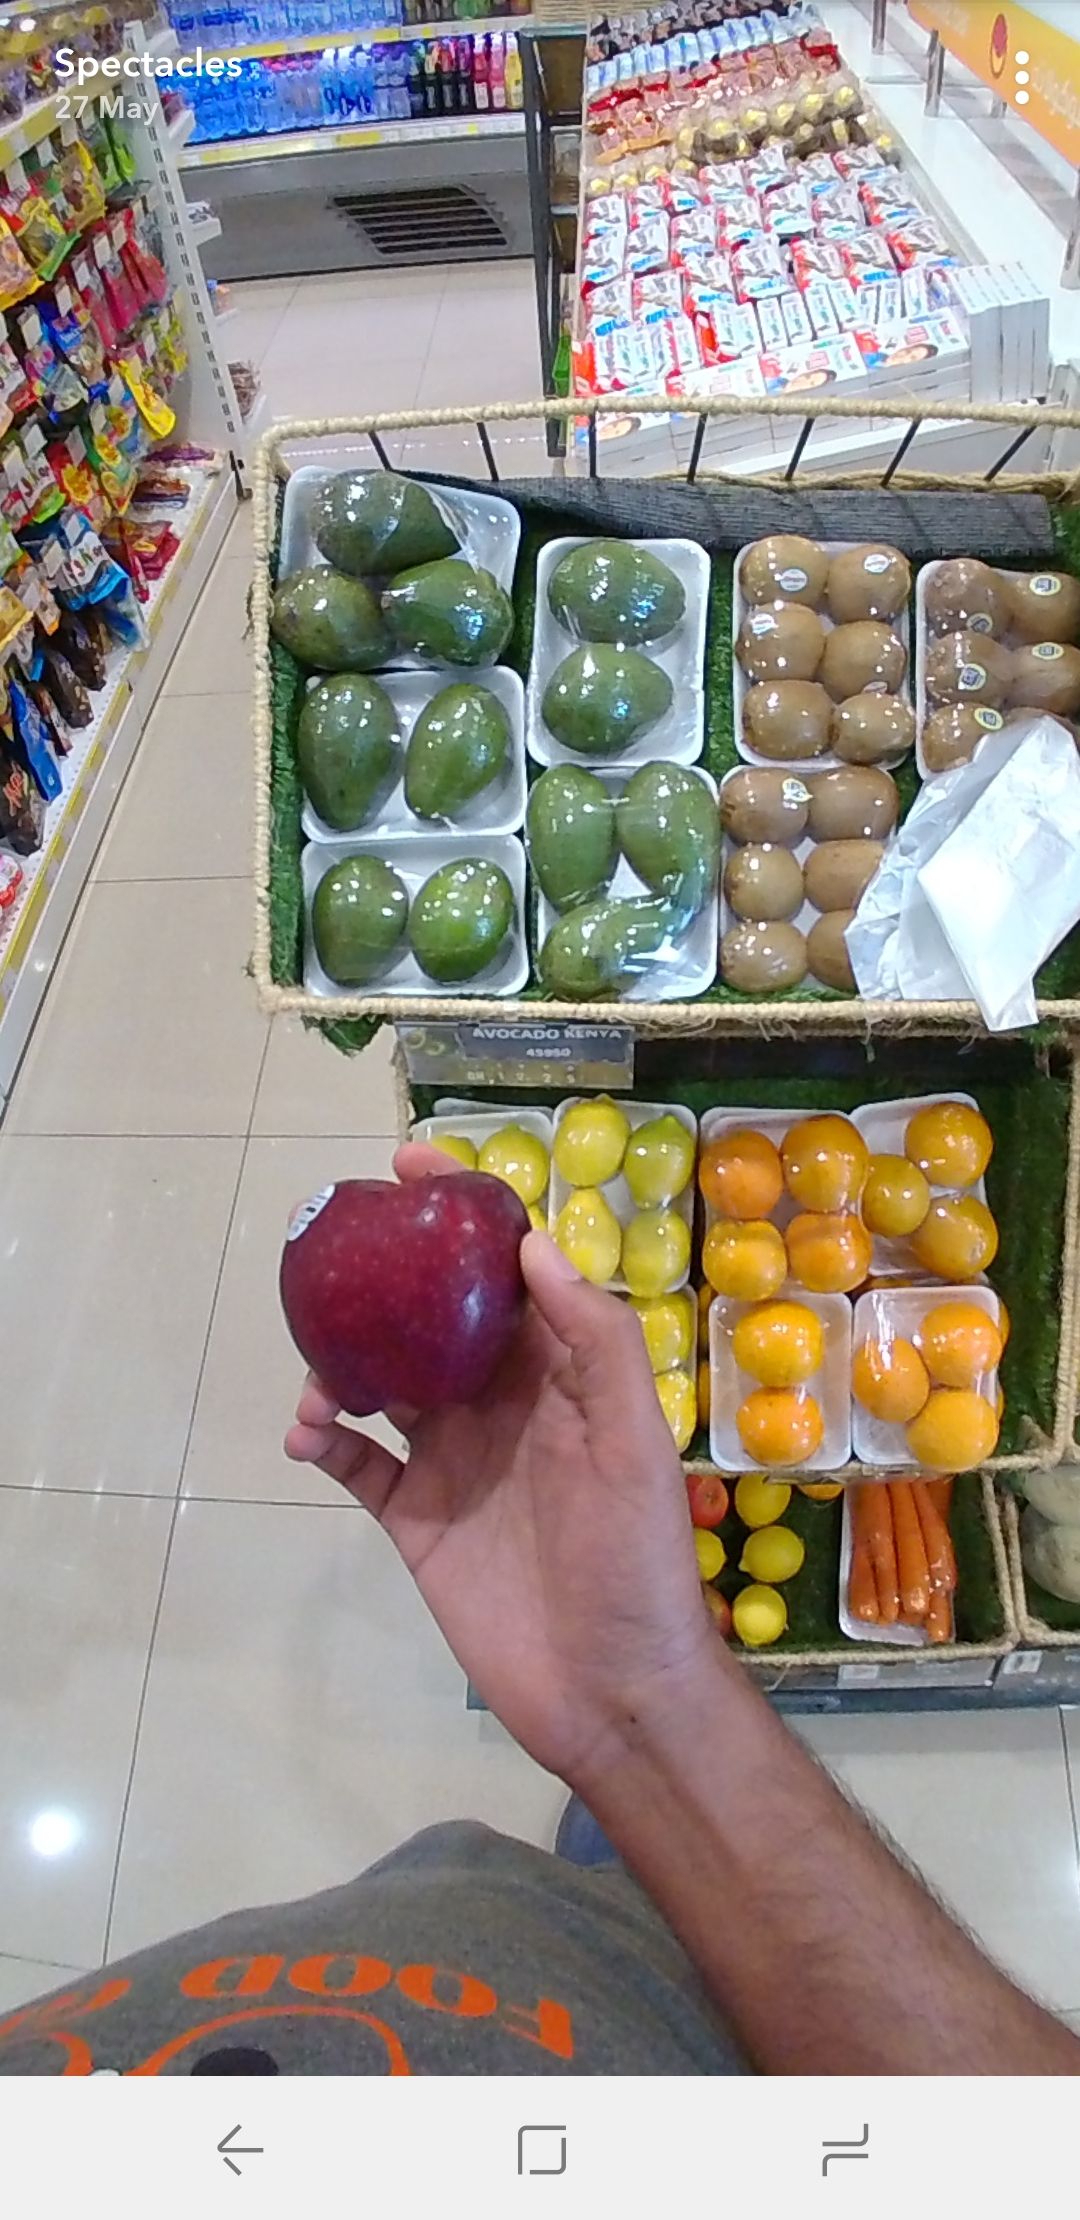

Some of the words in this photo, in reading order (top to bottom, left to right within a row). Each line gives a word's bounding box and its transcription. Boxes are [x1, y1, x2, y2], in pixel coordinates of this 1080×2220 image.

[472, 1029, 560, 1040] AVOCADO
[564, 1029, 622, 1039] KENYA
[180, 1953, 574, 2060] FOOD
